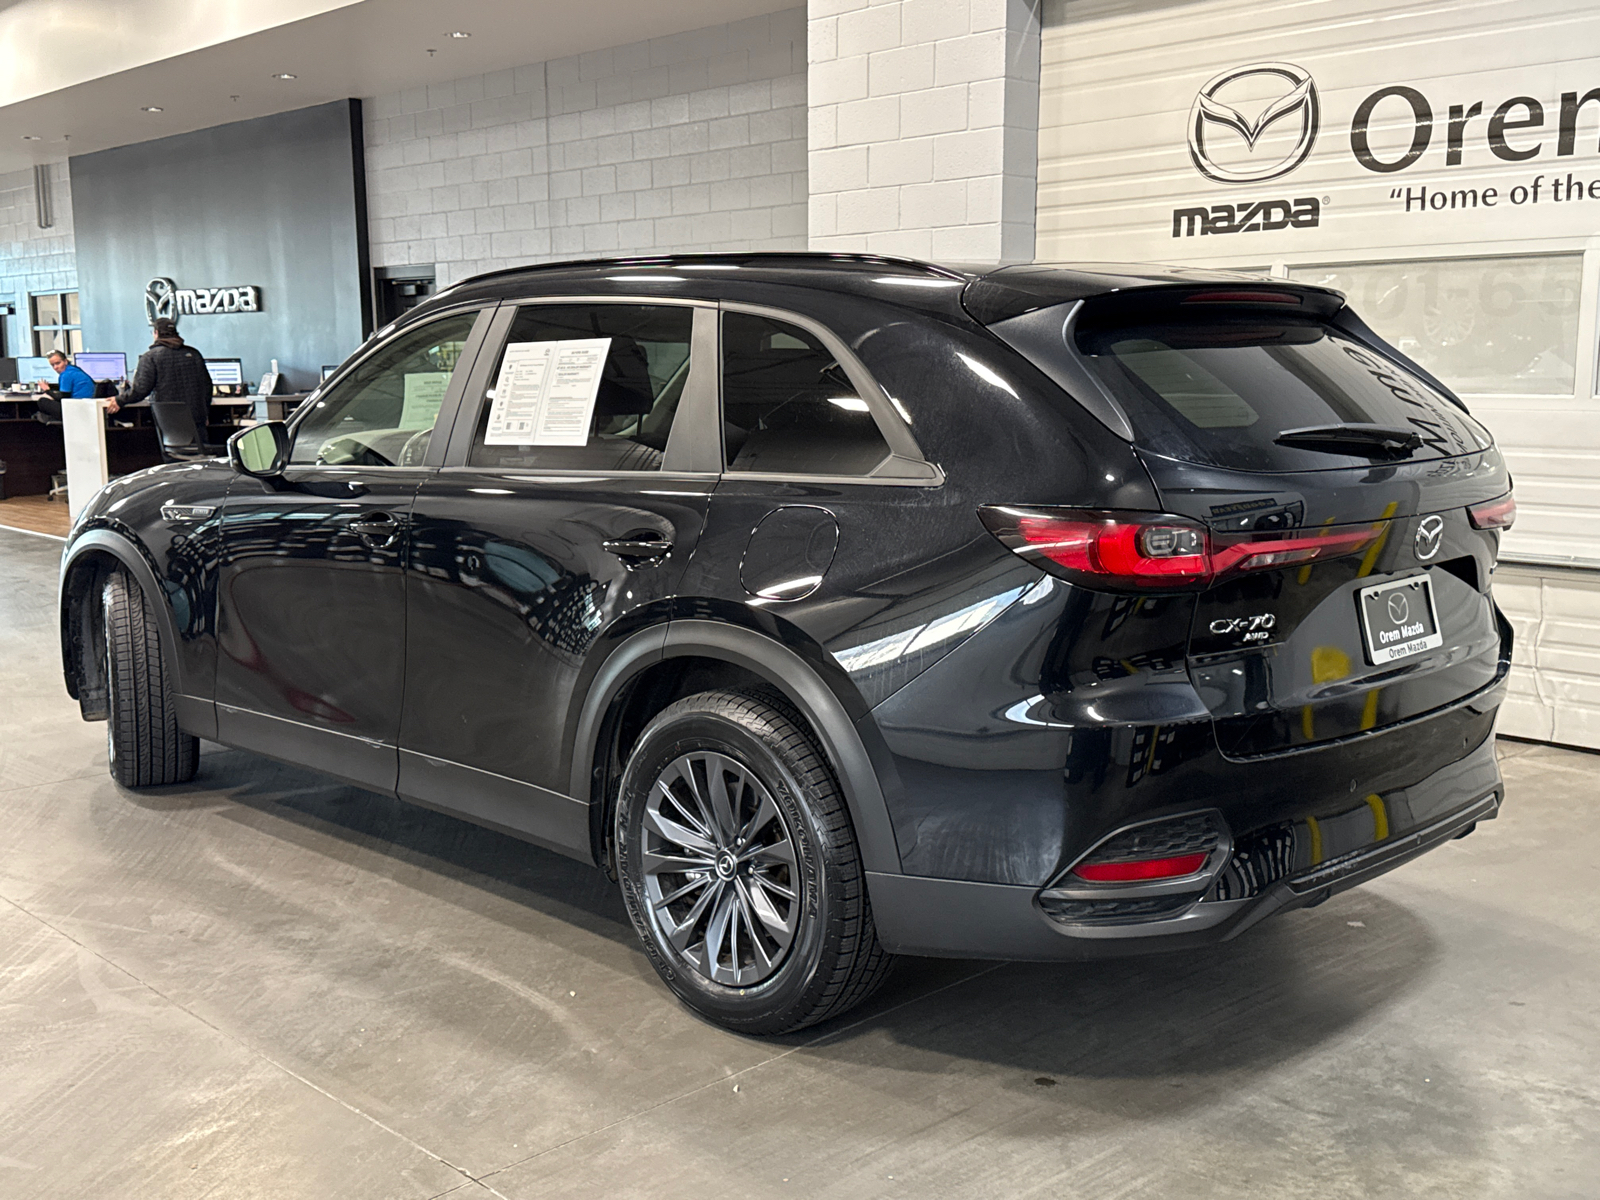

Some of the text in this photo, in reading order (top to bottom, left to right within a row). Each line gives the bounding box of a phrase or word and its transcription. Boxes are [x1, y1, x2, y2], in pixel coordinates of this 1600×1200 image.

[1510, 175, 1545, 205] of
[1551, 173, 1600, 202] the
[1209, 613, 1276, 634] CX-70
[1379, 621, 1424, 644] Orem Mazda
[1243, 631, 1269, 642] AWD
[1388, 640, 1428, 658] Orem Mazda
[776, 779, 819, 920] YOKOHAMA
